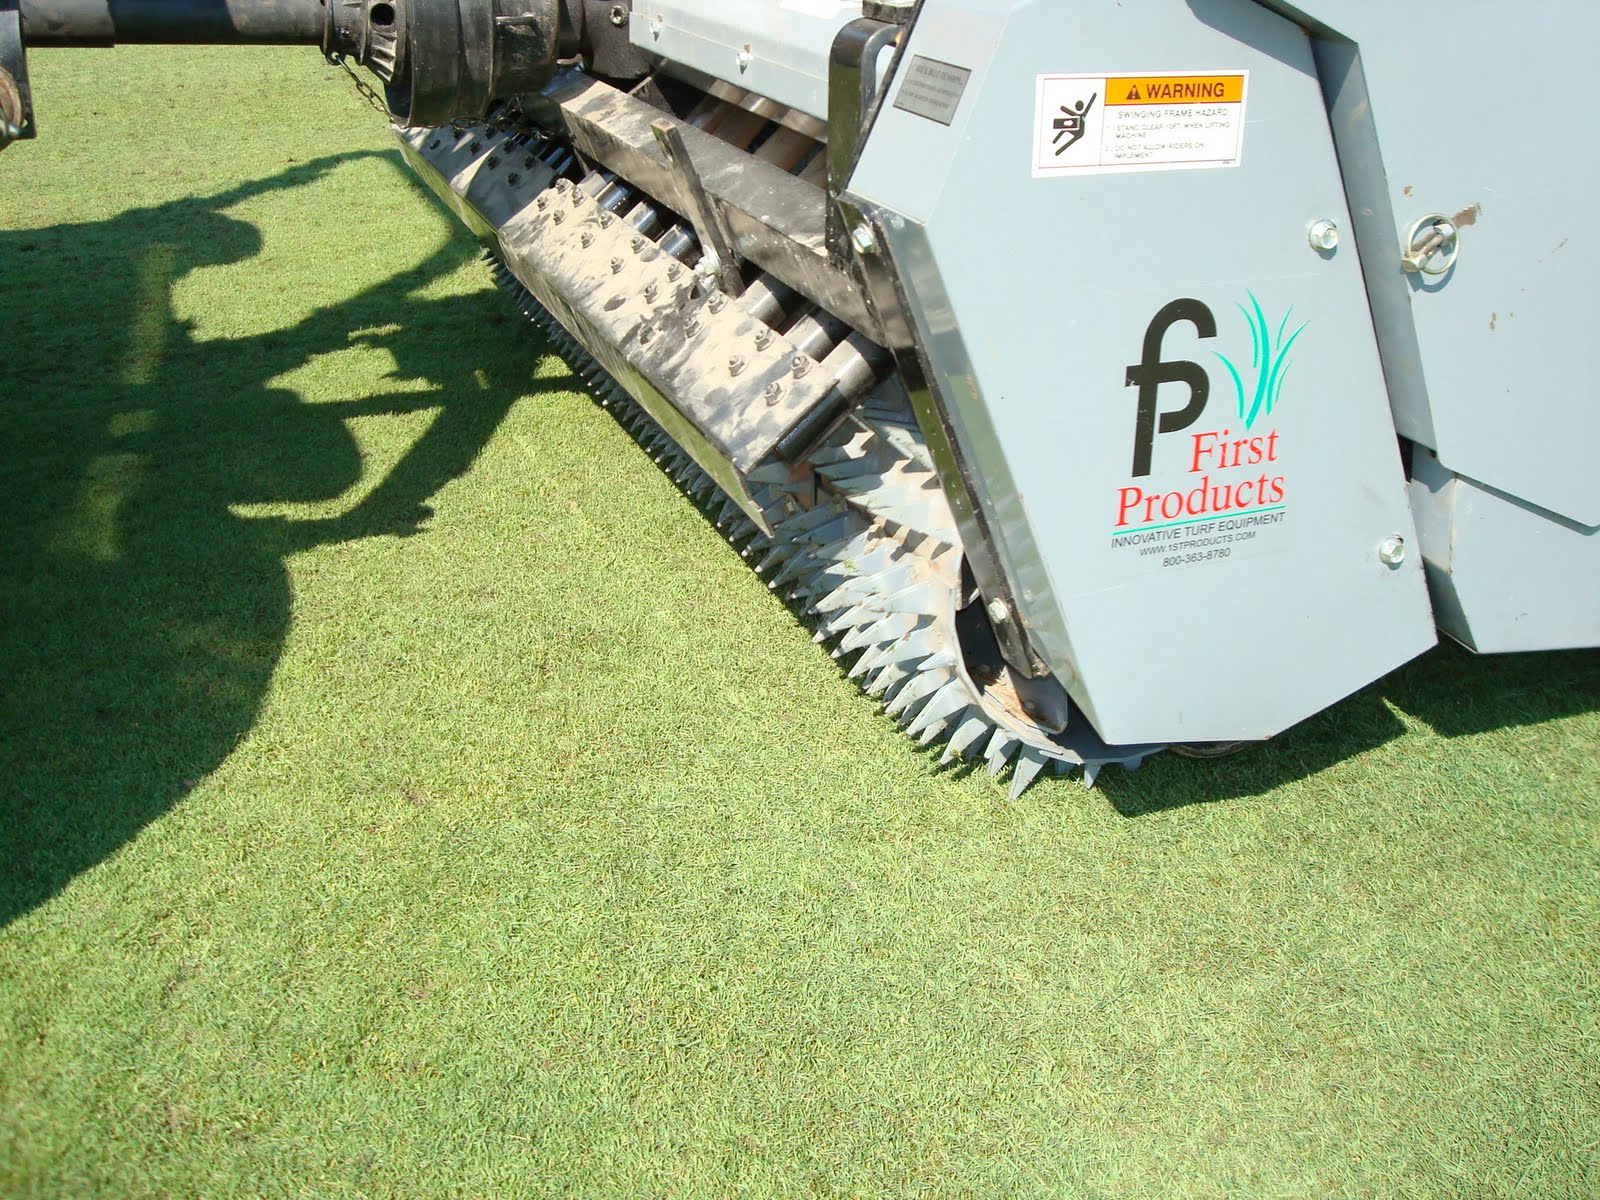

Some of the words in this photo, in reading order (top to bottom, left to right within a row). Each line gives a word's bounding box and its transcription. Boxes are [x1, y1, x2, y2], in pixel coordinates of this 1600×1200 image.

[1146, 82, 1225, 99] WARNING
[1118, 110, 1161, 119] SWINGING
[1164, 109, 1193, 117] FRAME
[1195, 108, 1229, 117] HAZARD
[1187, 428, 1280, 473] First
[1114, 472, 1286, 527] Products
[1111, 528, 1182, 549] INNOVATIVE
[1185, 522, 1216, 537] TURF
[1218, 512, 1286, 532] EQUIPMENT
[1139, 530, 1256, 556] WWW.1STPRODUCTS.COM
[1163, 547, 1231, 567] 800-363-8780
